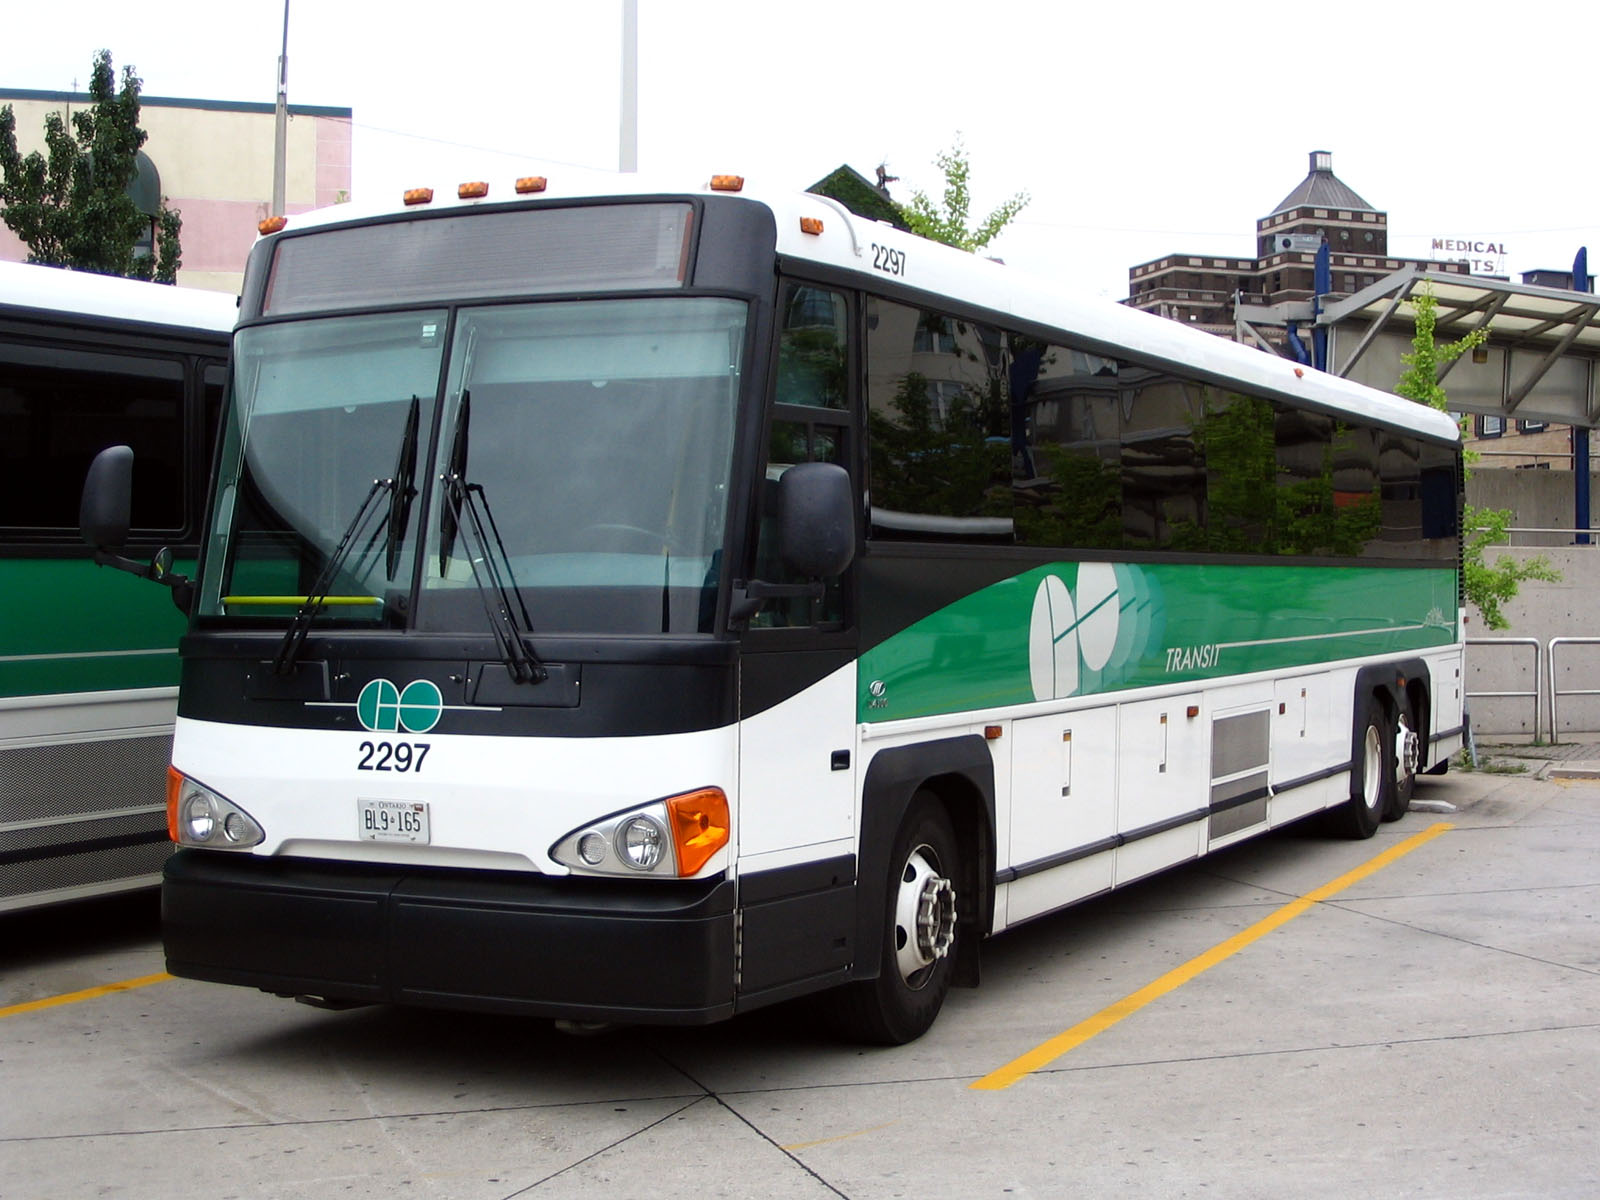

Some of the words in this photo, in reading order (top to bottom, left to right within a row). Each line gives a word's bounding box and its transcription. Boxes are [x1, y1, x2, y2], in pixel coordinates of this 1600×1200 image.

[871, 242, 906, 277] 2297
[1432, 238, 1508, 255] MEDICAL
[1165, 644, 1221, 673] TRANSIT
[357, 678, 443, 733] GO
[357, 741, 431, 773] 2297
